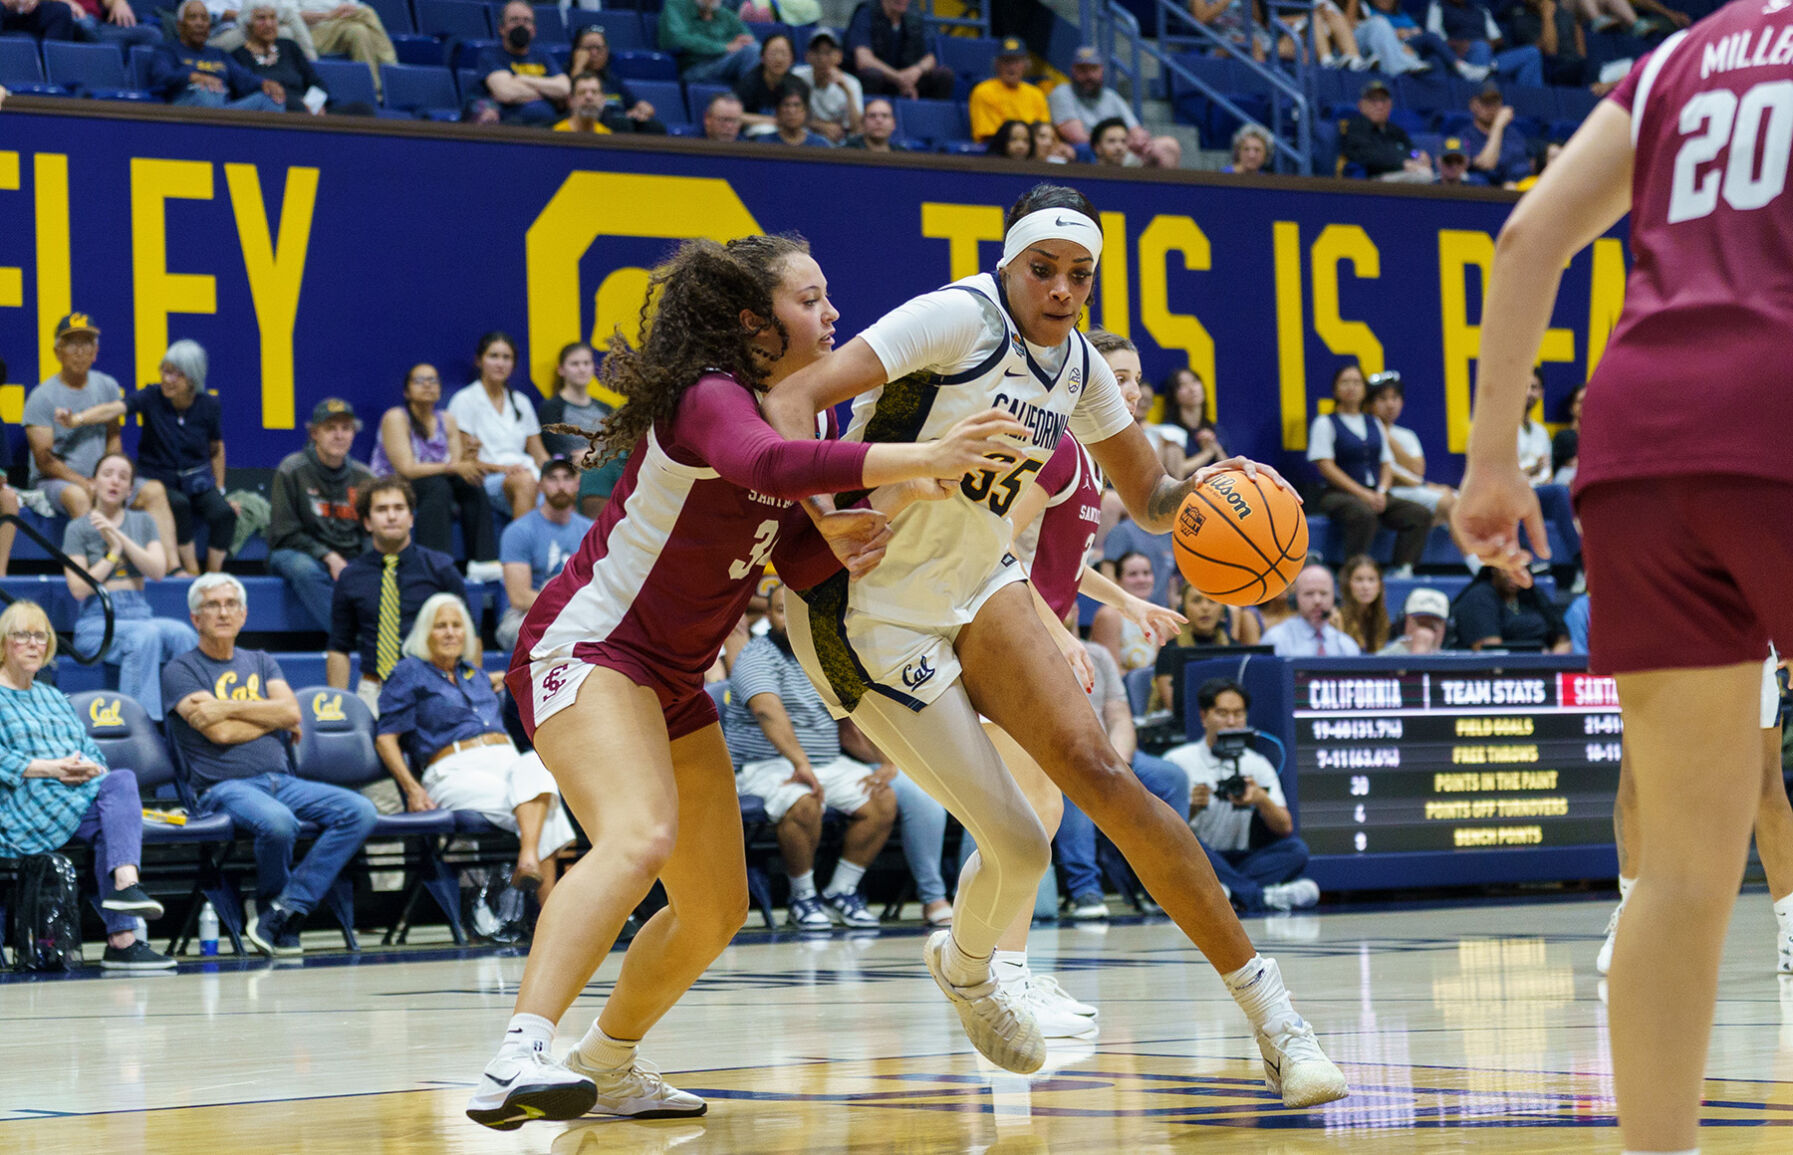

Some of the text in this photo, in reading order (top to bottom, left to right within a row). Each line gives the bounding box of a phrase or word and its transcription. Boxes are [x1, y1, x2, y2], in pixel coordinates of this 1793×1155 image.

[1667, 79, 1793, 224] 20
[0, 150, 320, 430] LEY
[921, 201, 1218, 425] TIS
[1274, 221, 1385, 451] IS
[960, 452, 1044, 518] 35
[1203, 474, 1252, 521] ilson
[215, 670, 265, 701] Cal
[902, 655, 936, 693] Cal
[312, 692, 347, 721] Cal
[1308, 678, 1403, 709] CALIFORNIA
[1441, 680, 1492, 705] TEAM
[1492, 679, 1547, 704] STATS
[89, 697, 126, 727] Cal
[1455, 718, 1493, 737] FIELD
[1493, 717, 1535, 736] GOALS
[1452, 745, 1486, 764] FREE
[1487, 744, 1540, 763] THROWS
[1434, 772, 1480, 793] POINTS
[1480, 771, 1496, 791] IN
[1496, 770, 1520, 791] THE
[1520, 769, 1559, 790] PAINT
[1425, 801, 1471, 819] POINTS
[1471, 799, 1497, 818] OFF
[1496, 797, 1569, 817] TURNOVERS
[1453, 827, 1497, 847] BENCH
[1497, 825, 1544, 845] POINTS
